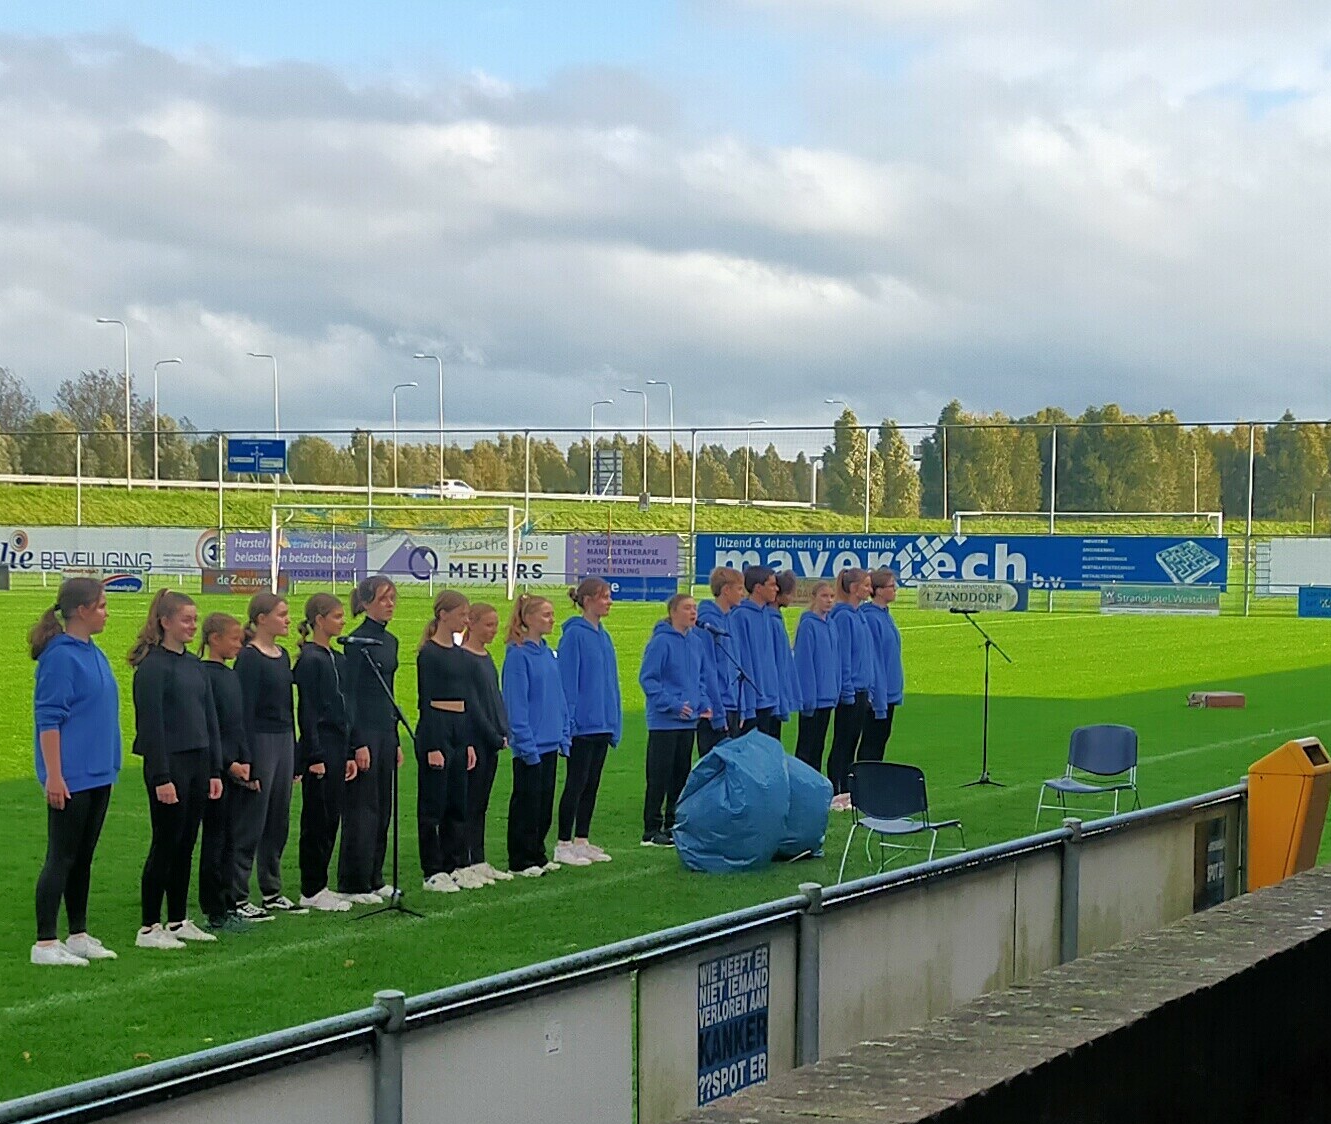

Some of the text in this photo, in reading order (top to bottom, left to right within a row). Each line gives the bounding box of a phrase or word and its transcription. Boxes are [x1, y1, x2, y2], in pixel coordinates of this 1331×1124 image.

[234, 538, 266, 548] Herstel
[715, 537, 897, 550] Uitzend & detachering in de techniek
[624, 548, 659, 556] THERAPIE
[715, 543, 1027, 586] mavertech
[216, 574, 230, 585] de
[1032, 572, 1066, 588] b.v.
[935, 591, 1003, 603] ZANDDORP
[1117, 592, 1172, 604] Strandhotel
[1173, 593, 1217, 604] Westduin
[699, 947, 769, 986] WIE HEEFT ER
[699, 966, 769, 1008] NIET IEMAND
[698, 986, 769, 1029] VERLOREN AAN
[698, 1010, 768, 1072] KANKER
[749, 1052, 767, 1081] ER
